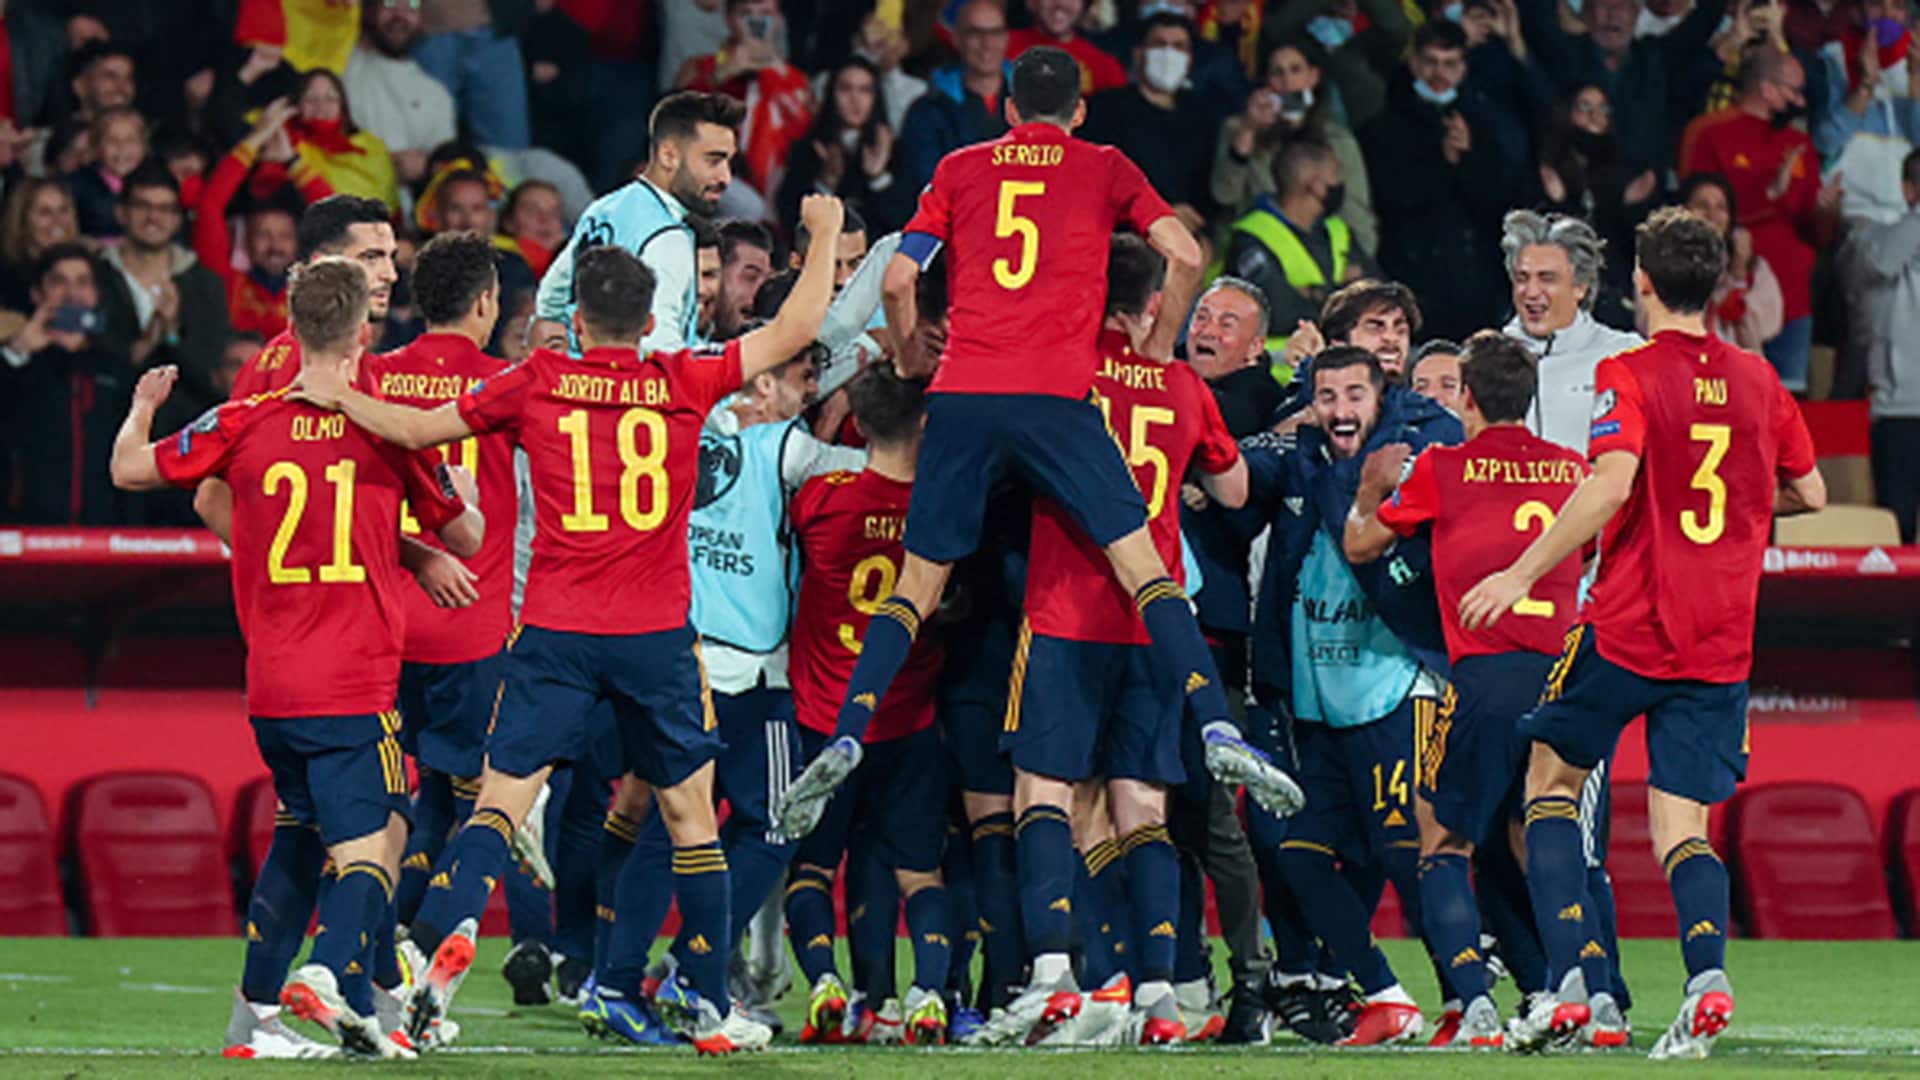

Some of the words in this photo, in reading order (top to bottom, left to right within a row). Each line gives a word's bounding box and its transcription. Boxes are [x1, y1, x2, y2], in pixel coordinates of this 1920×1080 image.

[991, 144, 1065, 167] SERGIO
[991, 180, 1046, 290] 5
[290, 414, 347, 442] OLMO
[620, 377, 671, 406] ALBA
[1693, 376, 1728, 406] PAU
[557, 406, 671, 532] 18
[1680, 422, 1732, 545] 3
[262, 458, 367, 584] 21
[838, 553, 897, 656] 9
[1372, 758, 1409, 812] 14
